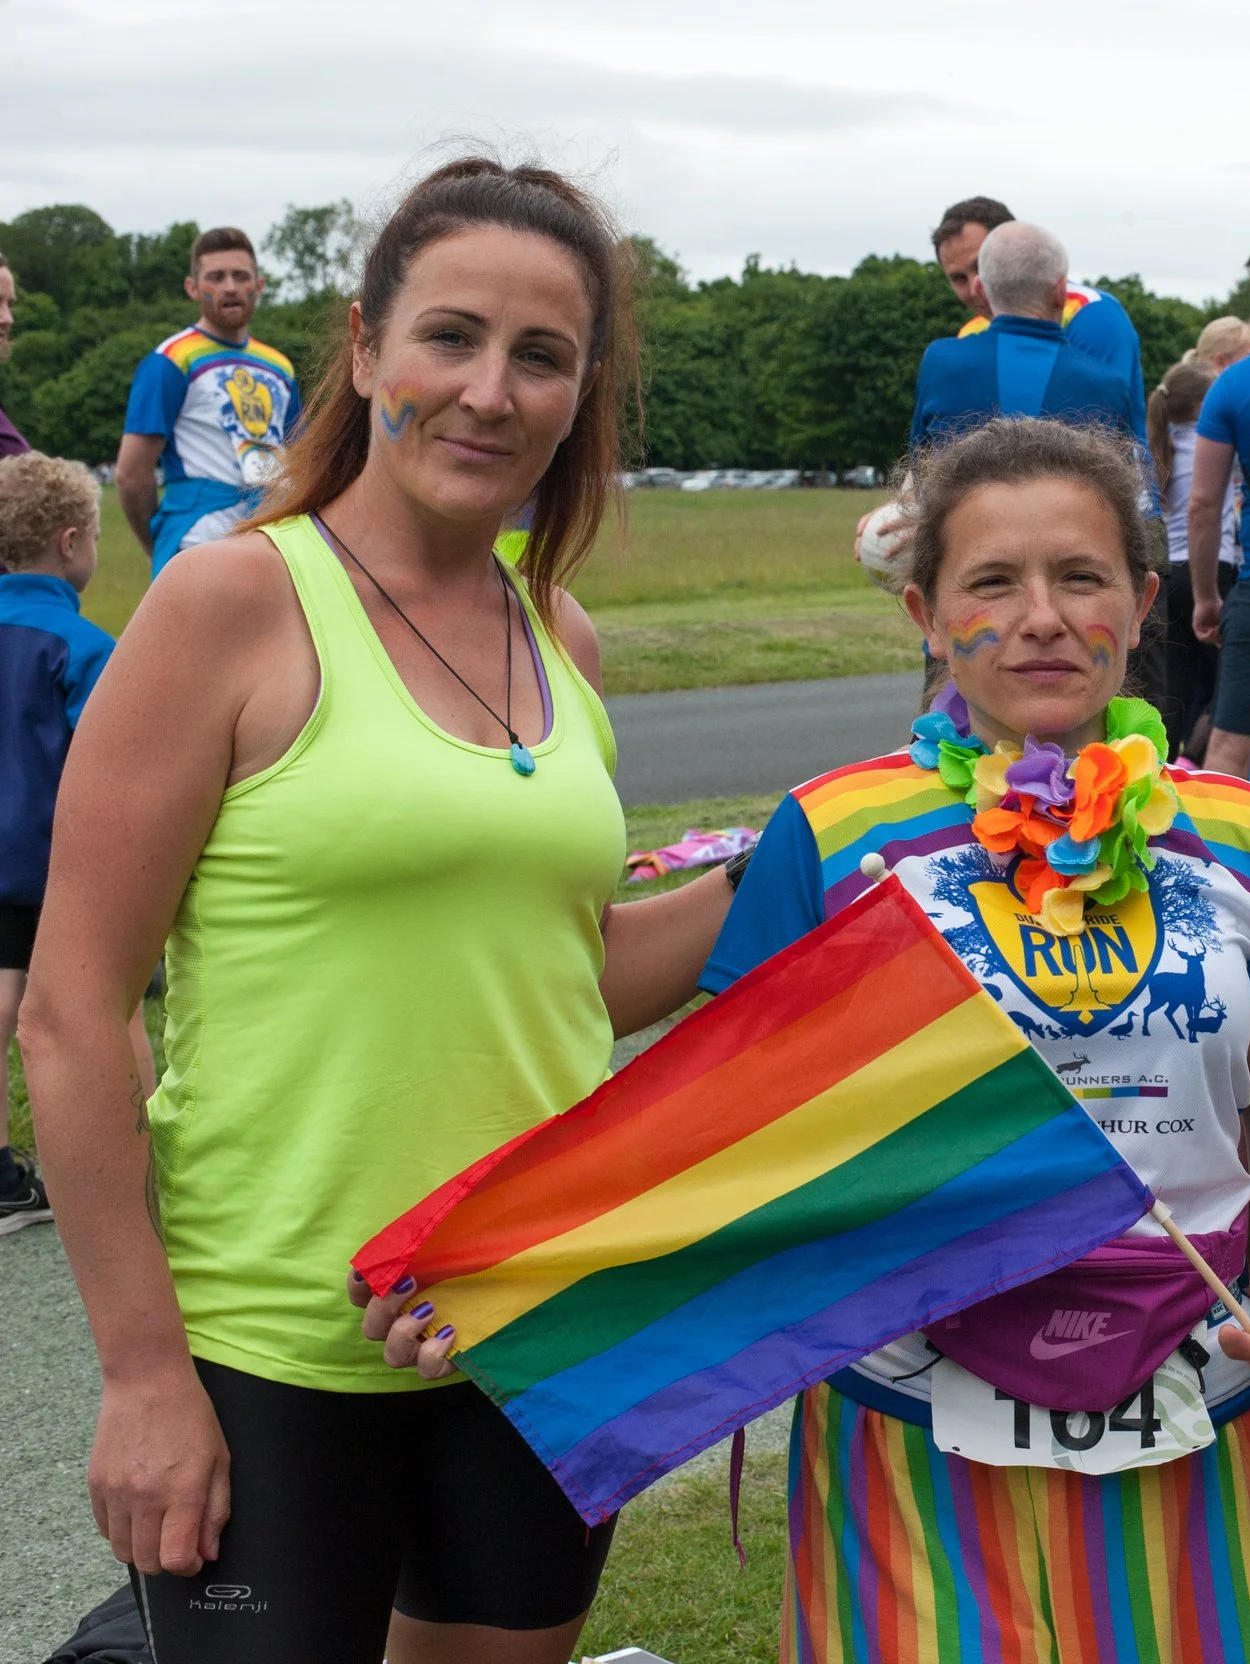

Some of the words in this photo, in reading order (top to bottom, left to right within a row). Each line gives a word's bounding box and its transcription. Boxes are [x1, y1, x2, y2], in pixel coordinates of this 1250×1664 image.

[1083, 914, 1121, 925] RIDE
[1018, 924, 1139, 977] RUN
[1062, 1074, 1131, 1086] UNNERS
[1138, 1074, 1169, 1084] A.C.
[1156, 1118, 1195, 1134] COX
[1045, 1309, 1111, 1340] NIKE
[189, 1599, 268, 1613] Kalenji
